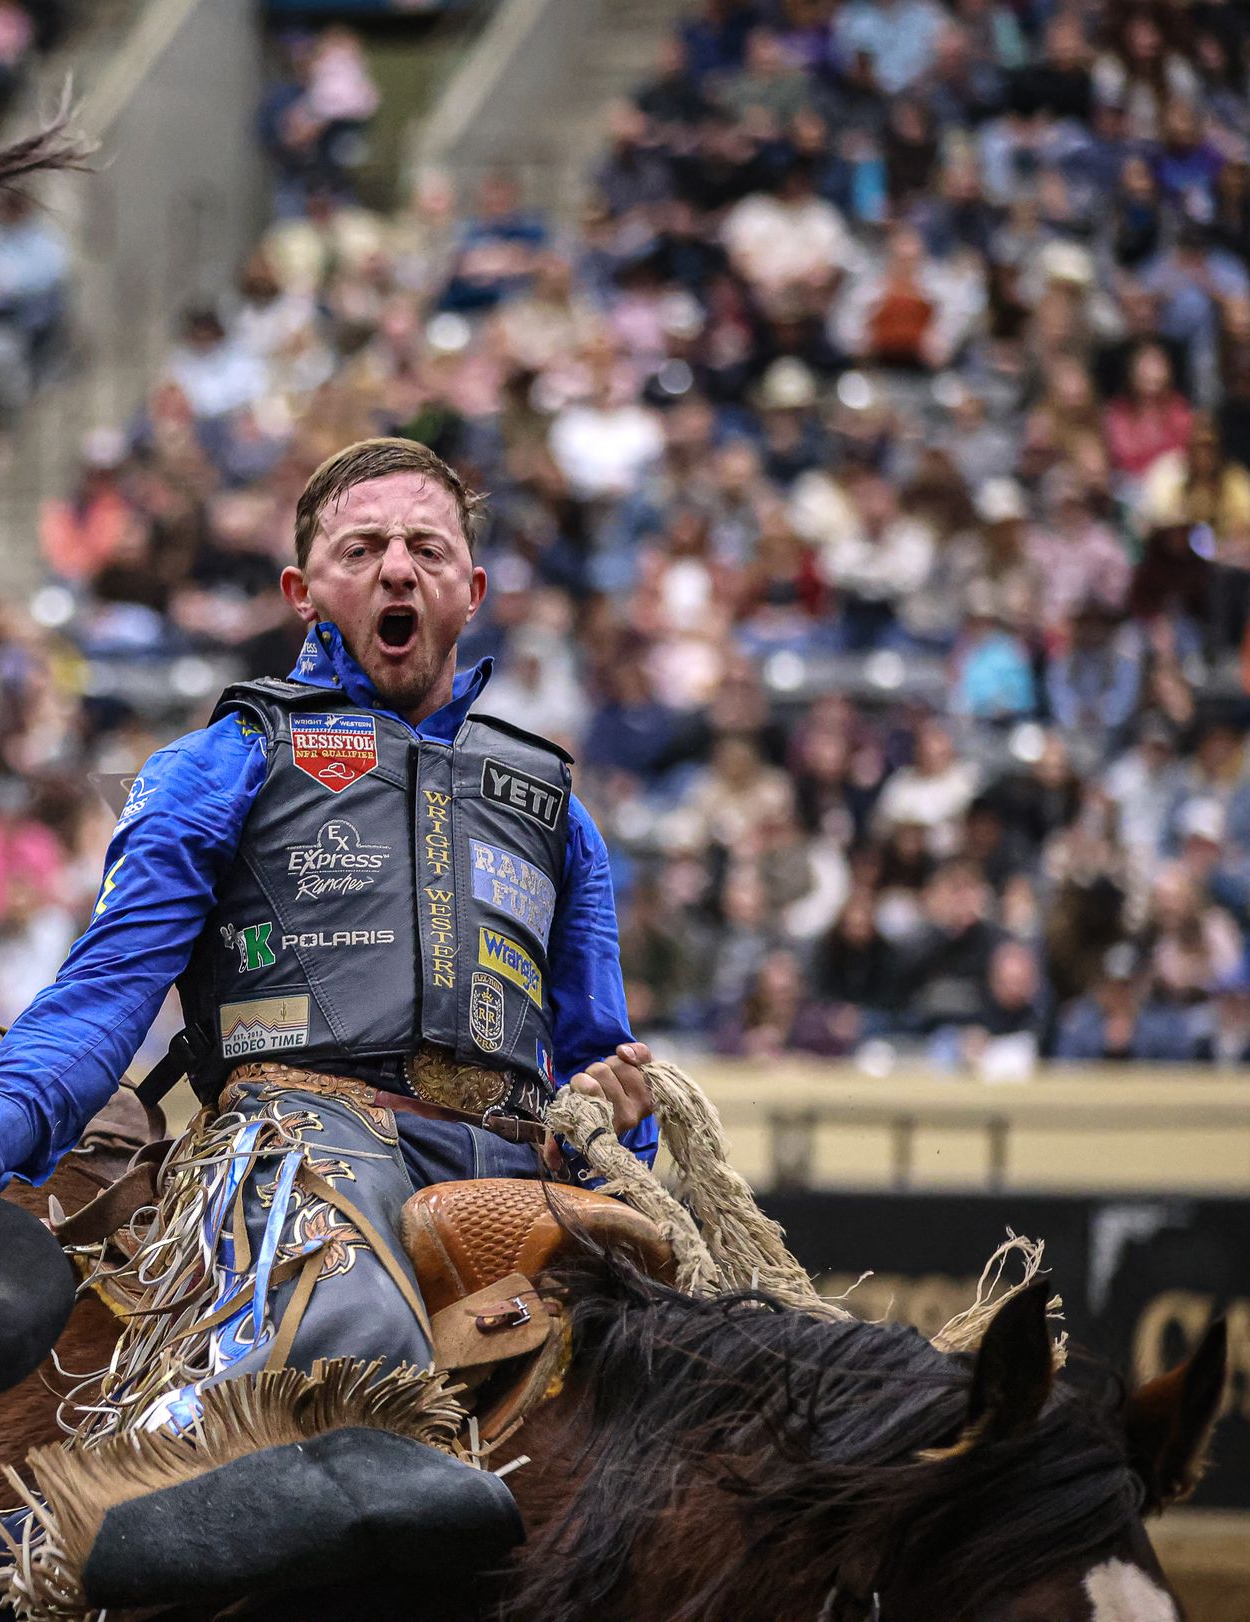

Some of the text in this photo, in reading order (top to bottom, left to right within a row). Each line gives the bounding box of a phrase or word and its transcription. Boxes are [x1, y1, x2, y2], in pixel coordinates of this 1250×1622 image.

[339, 720, 372, 728] WESTERN
[294, 733, 375, 751] RESISTOL
[296, 750, 375, 760] NFR QUALIFIER
[489, 767, 558, 821] YETI
[295, 873, 374, 900] Ranches
[423, 790, 456, 989] WRIGHT WESTERN
[281, 930, 395, 950] POLARIS
[224, 1033, 305, 1056] RODEO TIME
